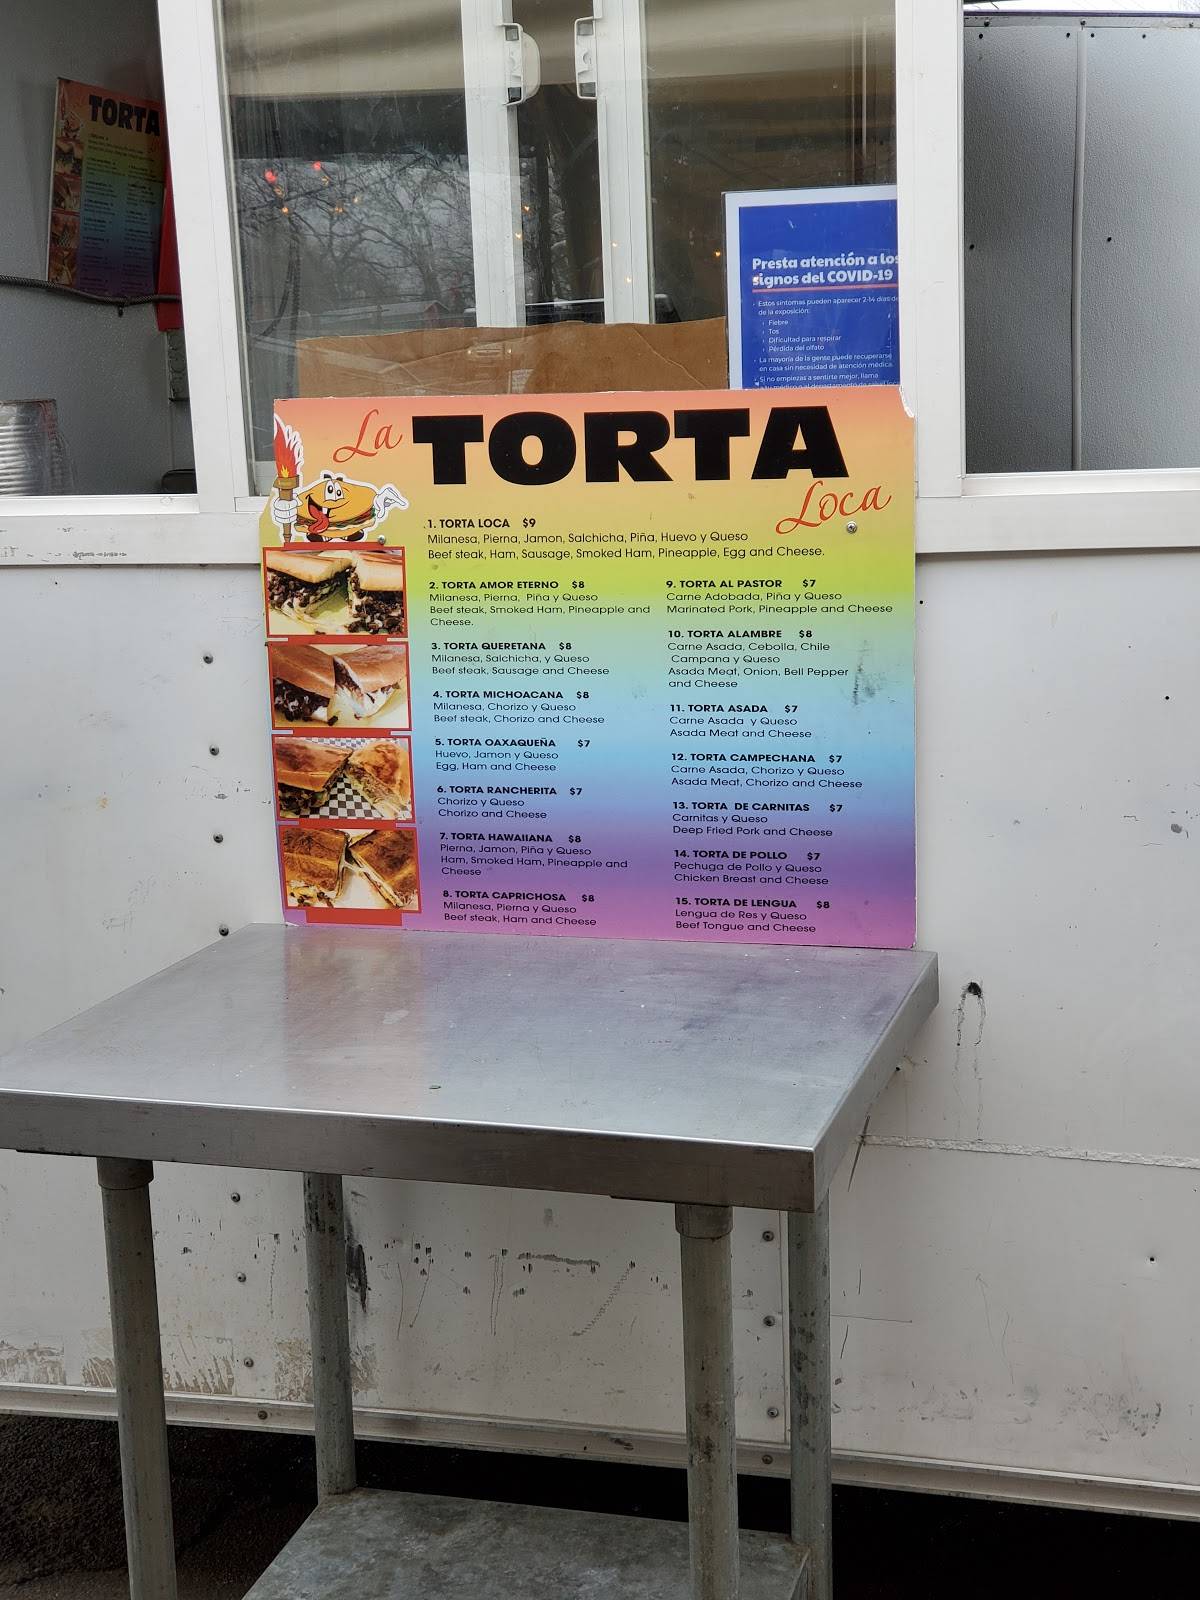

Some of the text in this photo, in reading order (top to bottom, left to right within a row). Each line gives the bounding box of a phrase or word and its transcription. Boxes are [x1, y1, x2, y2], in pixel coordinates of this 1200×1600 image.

[89, 94, 160, 136] TORTA
[752, 256, 797, 269] Presta
[800, 253, 864, 268] atención
[867, 256, 877, 266] a
[752, 269, 893, 288] signos del COVID-19
[806, 297, 831, 306] pueden
[767, 307, 773, 315] la
[817, 335, 840, 344] respirar
[768, 343, 824, 353] Pérdida del olfato
[812, 354, 830, 363] gente
[831, 354, 852, 363] puede
[333, 406, 850, 485] La TORTA
[775, 480, 892, 535] Loca
[427, 517, 535, 528] 1. TORTA LOCA $9
[428, 532, 748, 543] Milanesa, Pierna, Jamon, Salchicha, Piña, Huevo y Queso
[428, 547, 824, 560] Beef steak, Ham, Sausage, Smoked Ham, Pineapple, Egg and Cheese.
[572, 580, 584, 589] $8
[802, 578, 815, 587] $7
[799, 630, 812, 638] $8
[559, 642, 571, 650] $8
[671, 654, 729, 664] Campana
[445, 690, 479, 698] TORTA
[576, 691, 589, 699] $8
[687, 704, 724, 712] TORTA
[784, 704, 797, 713] $7
[434, 714, 456, 722] Beef
[460, 715, 490, 723] steak,
[537, 715, 559, 723] and
[562, 715, 604, 723] Cheese
[484, 737, 555, 746] OAXAQUEÑA
[577, 739, 590, 747] $7
[690, 753, 726, 761] TORTA
[730, 754, 815, 762] CAMPECHANA
[829, 754, 842, 763] $7
[487, 786, 557, 794] RANCHERITA
[569, 787, 582, 795] $7
[672, 801, 688, 809] 13.
[734, 802, 748, 810] DE
[752, 802, 809, 810] CARNITAS
[829, 804, 842, 812] $7
[672, 813, 767, 824] Carnitas y Queso
[450, 832, 485, 840] TORTA
[568, 835, 581, 843] $8
[692, 850, 729, 858] TORTA
[750, 851, 787, 859] POLLO
[807, 852, 820, 860] $7
[441, 866, 481, 875] Cheese
[454, 890, 489, 898] TORTA
[491, 891, 566, 900] CAPRICHOSA
[581, 893, 594, 902] $8
[675, 897, 829, 909] 15. TORTA DE LENGUA $8
[676, 921, 815, 932] Beef Tongue and Cheese
